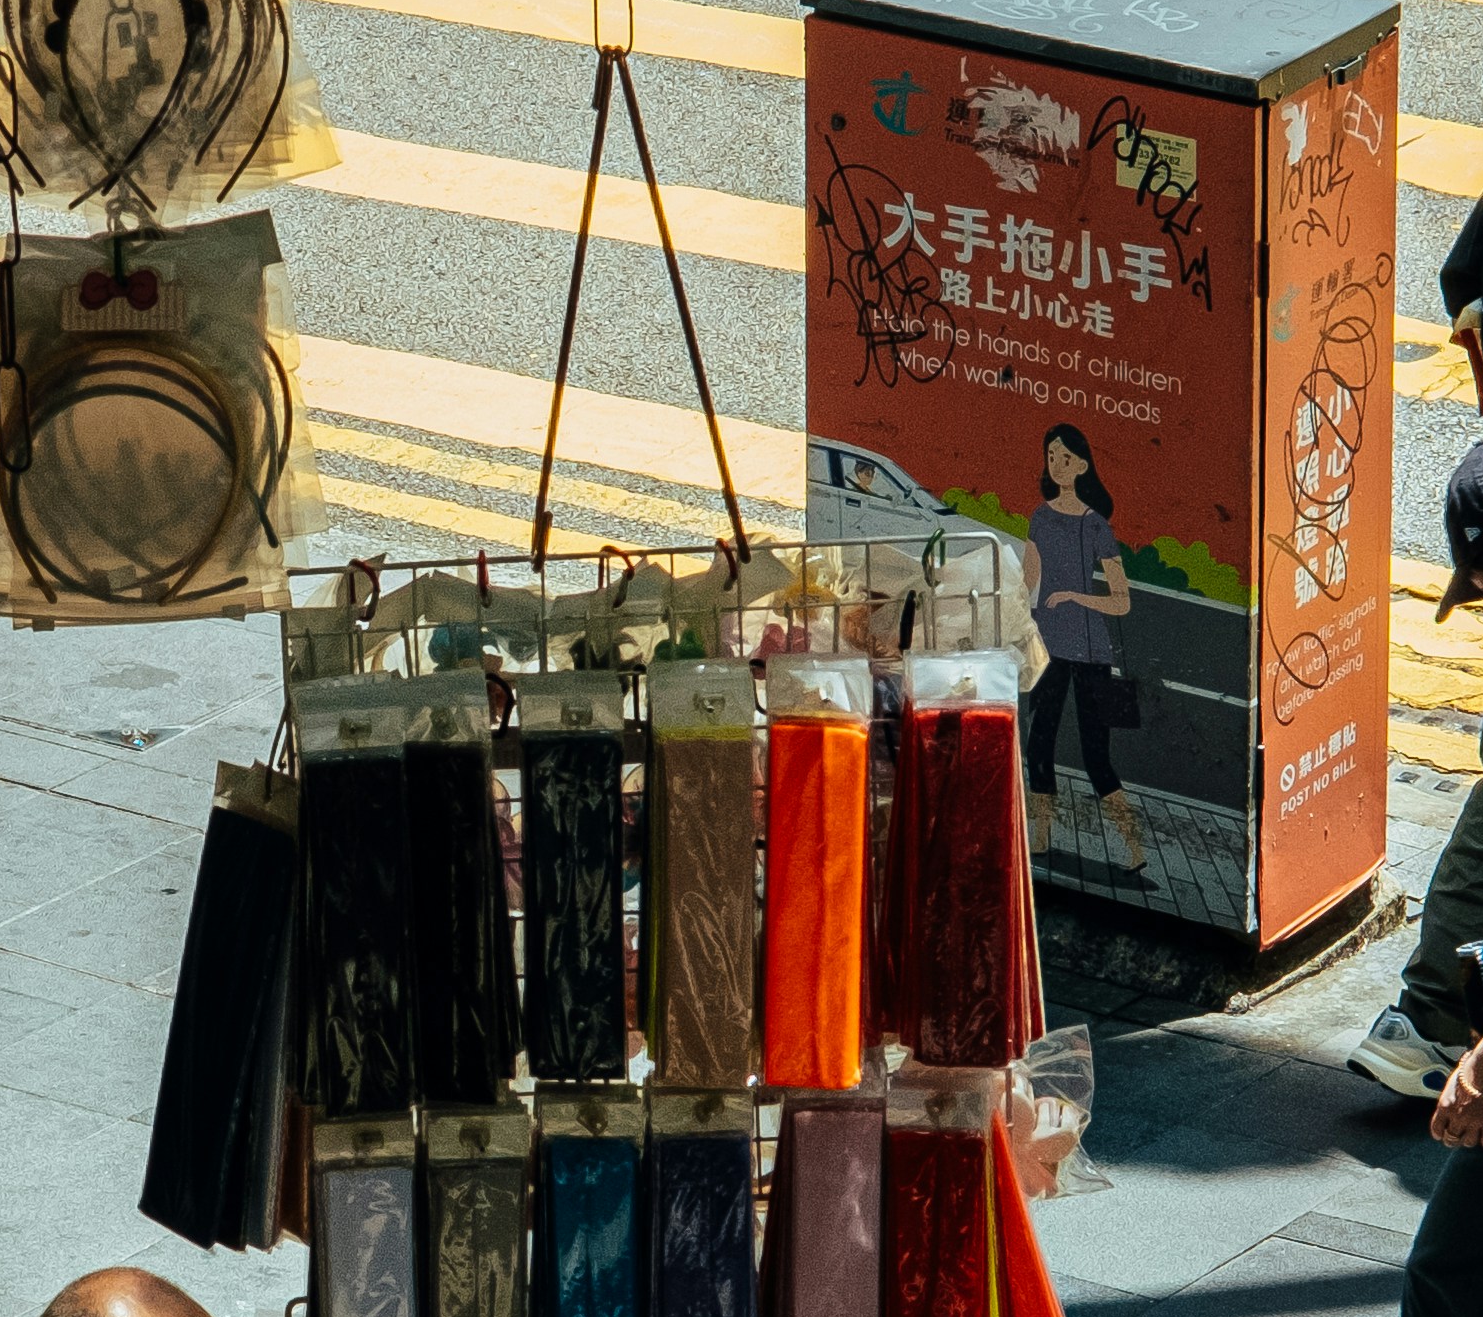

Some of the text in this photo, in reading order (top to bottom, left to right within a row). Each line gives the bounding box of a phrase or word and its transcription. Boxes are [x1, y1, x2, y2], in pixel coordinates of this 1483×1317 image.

[882, 191, 1175, 303] 大手拖小手
[939, 266, 1116, 340] 路上小心走
[895, 348, 1162, 425] when walking on roads
[932, 319, 970, 346] the
[978, 327, 1051, 365] hands
[1057, 349, 1082, 372] of
[1087, 357, 1183, 396] children
[1336, 596, 1377, 633] signals
[1341, 627, 1363, 653] out
[1297, 719, 1358, 782] 禁止標貼
[1280, 757, 1358, 822] POST NO BILL
